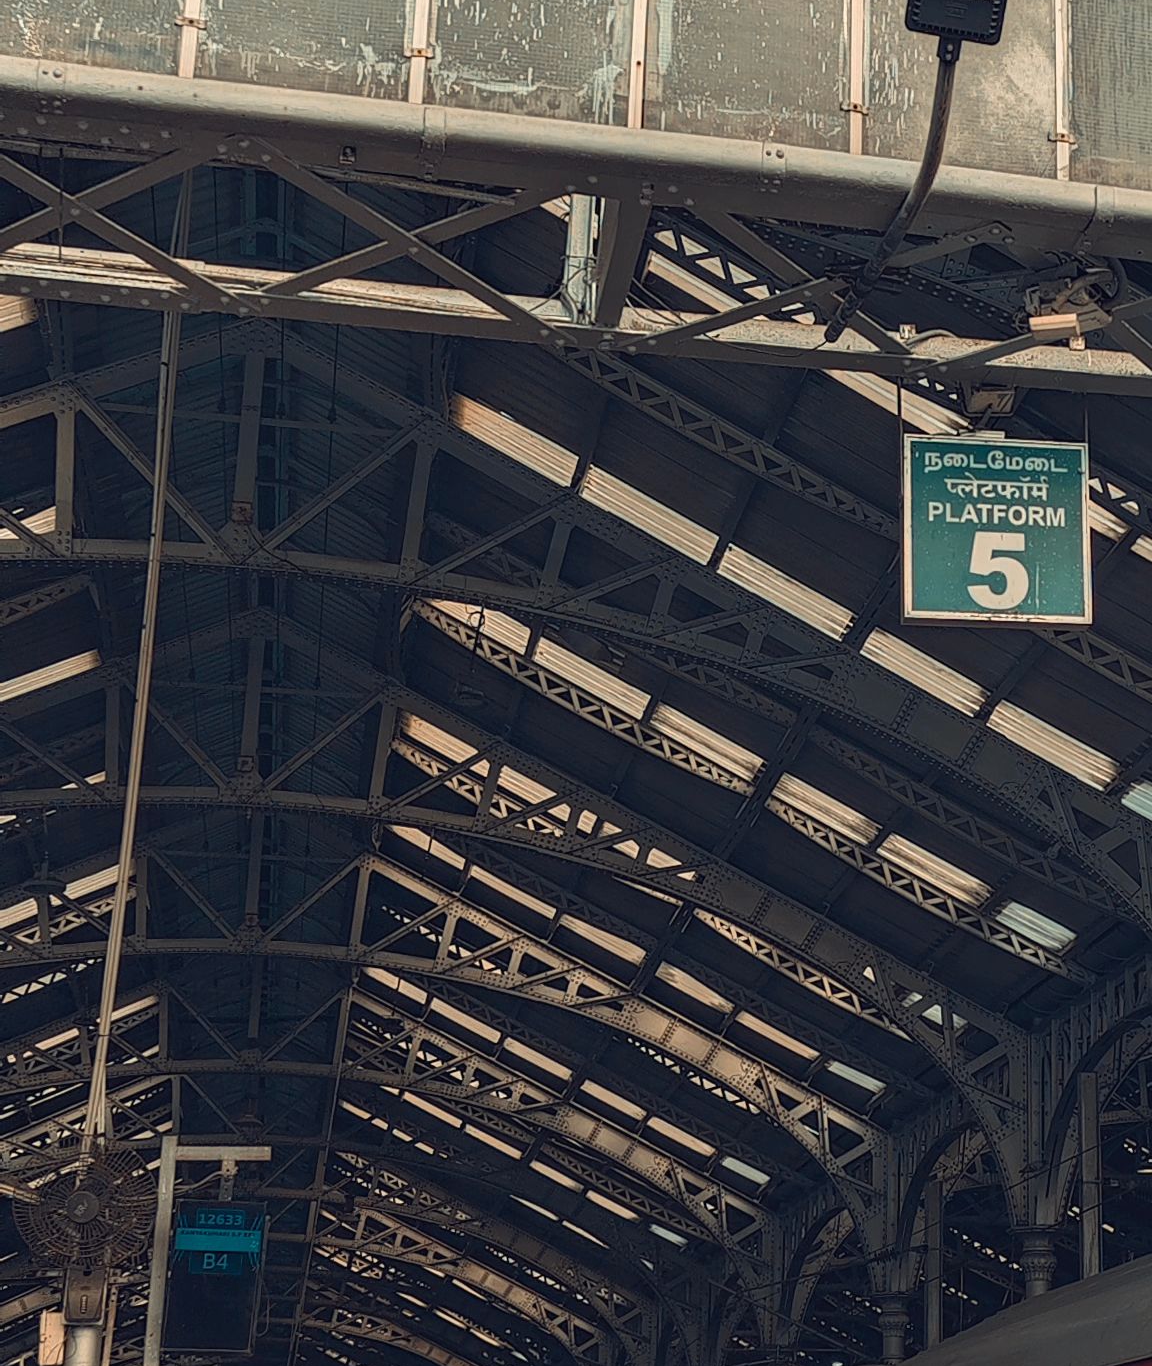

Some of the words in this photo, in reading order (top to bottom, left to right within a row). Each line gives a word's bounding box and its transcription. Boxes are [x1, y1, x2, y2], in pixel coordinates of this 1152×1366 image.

[924, 450, 1068, 473] நடைமேடை
[944, 471, 1050, 501] प्लेटफॉर्म
[928, 502, 1066, 527] PLATFORM
[967, 531, 1029, 610] 5
[199, 1213, 242, 1226] 12633
[203, 1253, 228, 1270] B4
